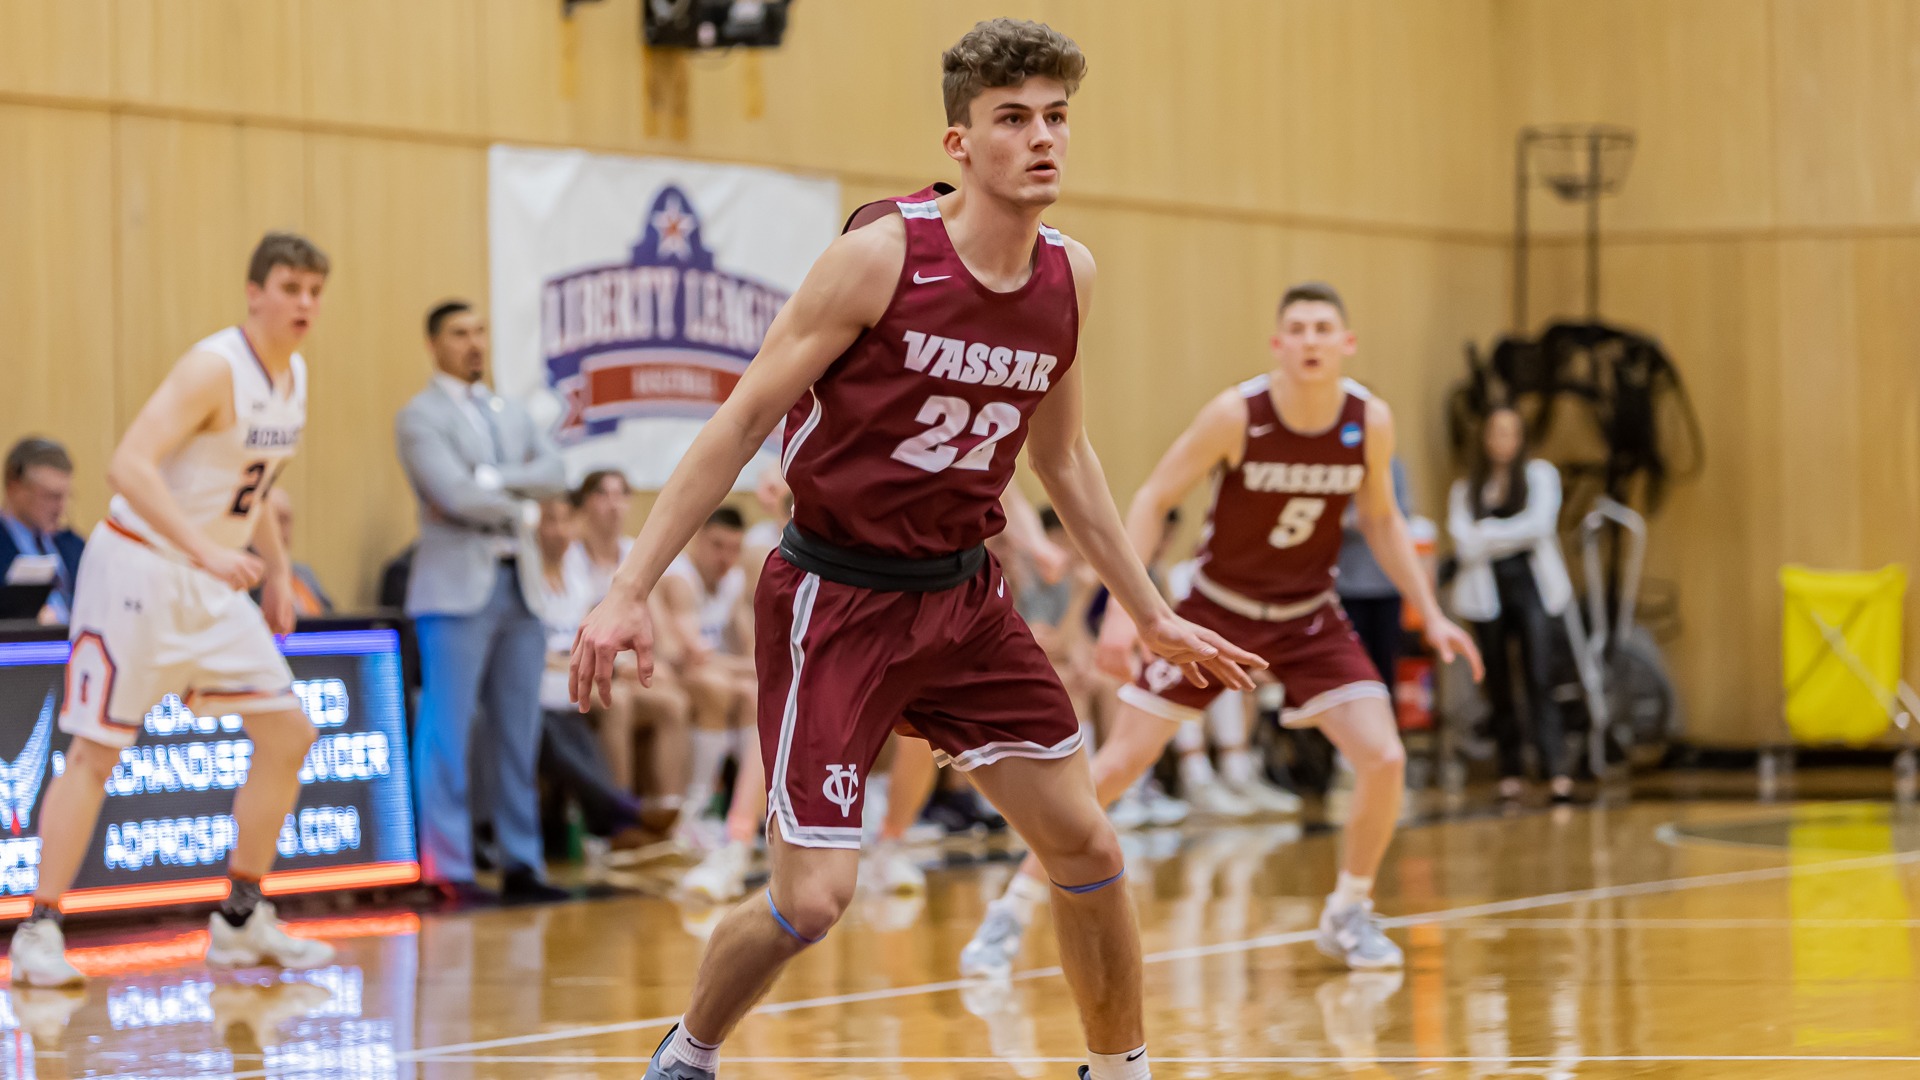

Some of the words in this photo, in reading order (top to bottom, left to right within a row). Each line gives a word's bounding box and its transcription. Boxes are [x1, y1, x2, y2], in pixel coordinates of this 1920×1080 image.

[682, 267, 788, 354] LEAG
[902, 330, 1058, 392] VASSAR
[890, 395, 1021, 473] 22
